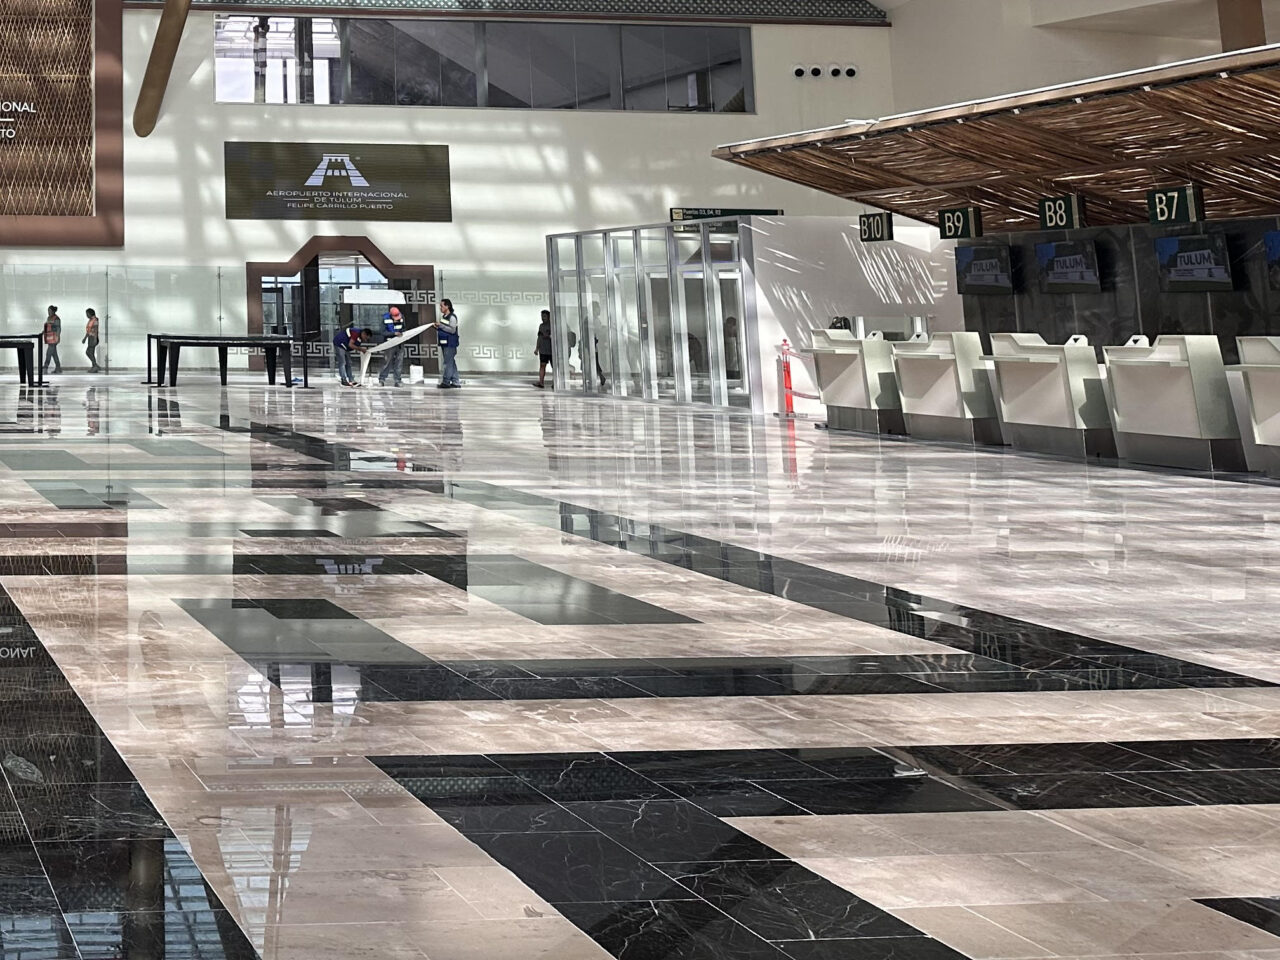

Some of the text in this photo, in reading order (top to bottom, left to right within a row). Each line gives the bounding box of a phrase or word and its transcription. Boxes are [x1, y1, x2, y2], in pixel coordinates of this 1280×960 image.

[1045, 199, 1067, 227] B8
[1155, 191, 1178, 221] B7
[861, 216, 882, 239] B10
[945, 211, 964, 236] B9
[973, 261, 998, 273] TULUM
[1055, 258, 1084, 270] TULUM
[1178, 252, 1212, 266] TULUM
